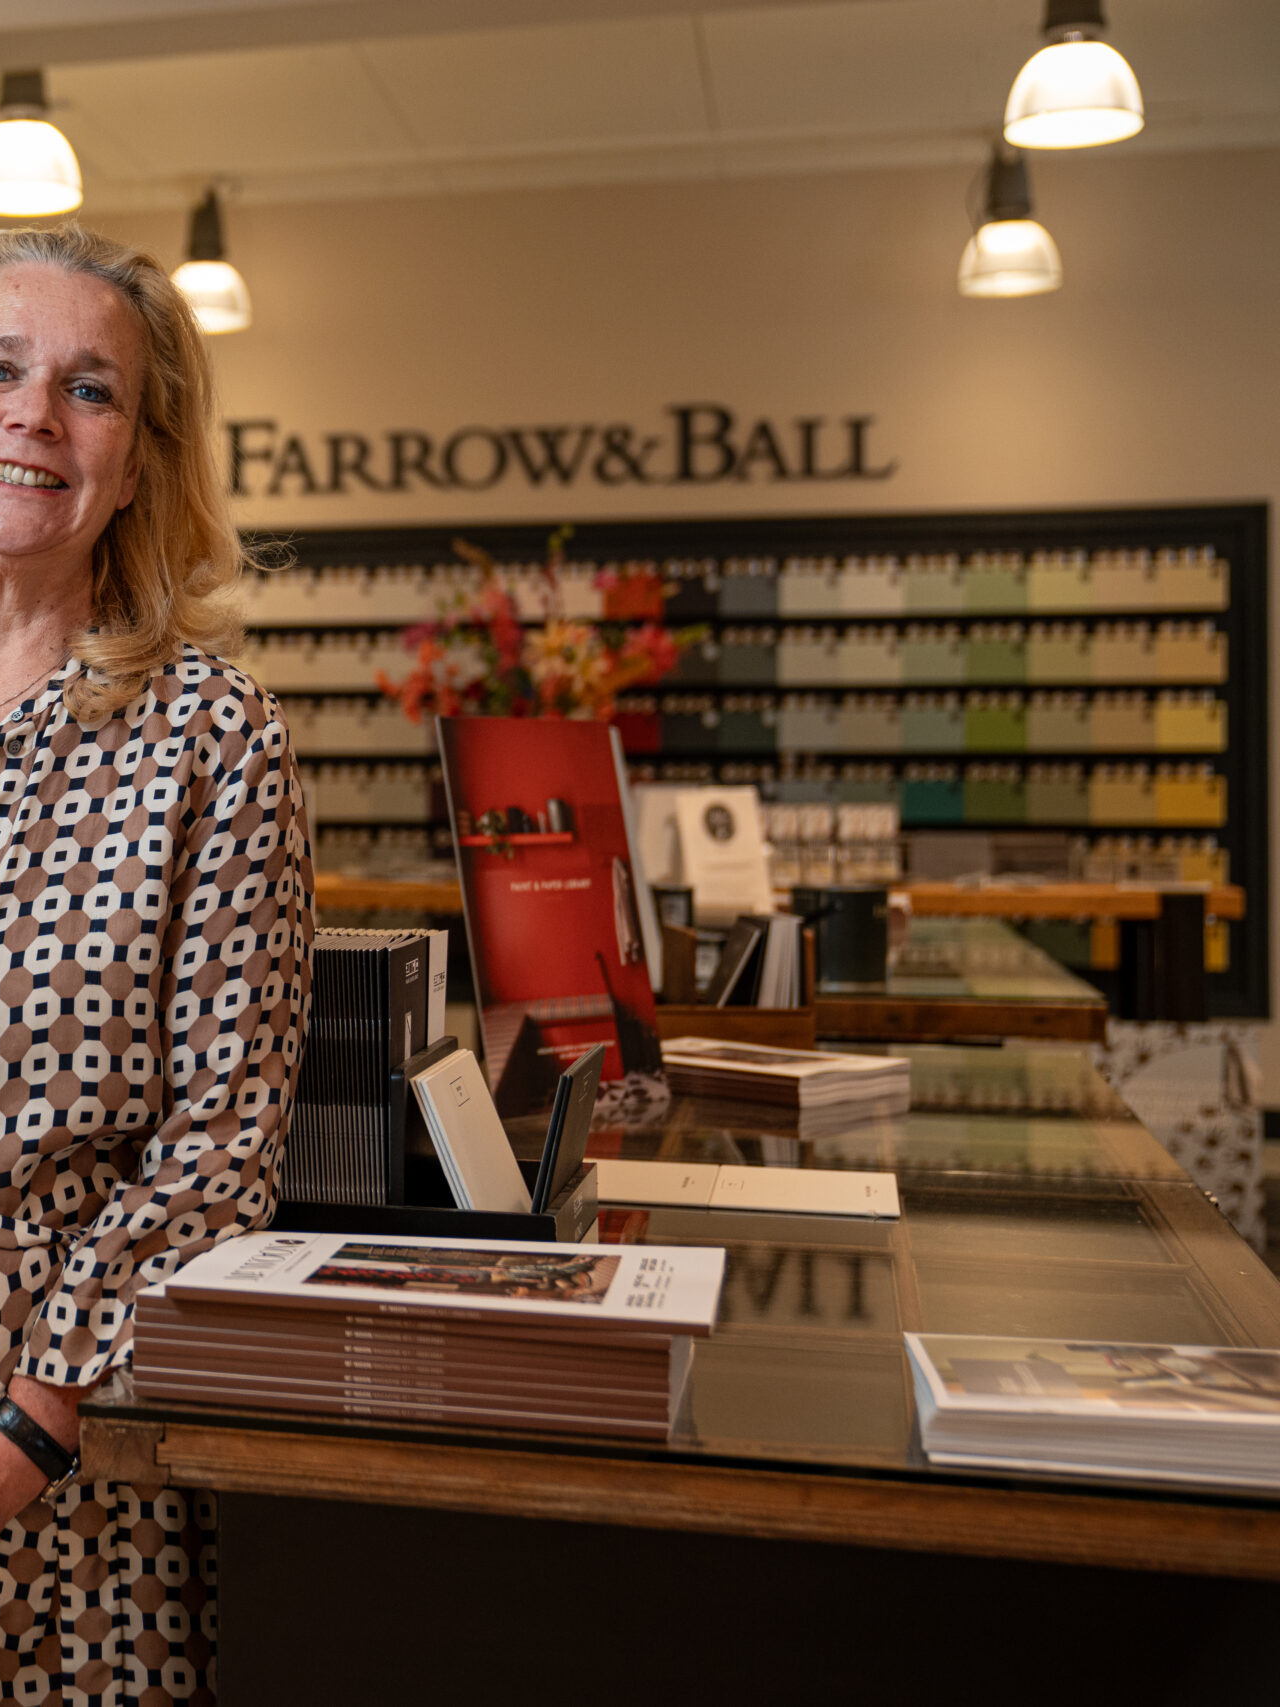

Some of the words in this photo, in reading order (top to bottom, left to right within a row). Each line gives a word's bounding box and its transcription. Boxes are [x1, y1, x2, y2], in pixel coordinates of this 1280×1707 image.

[510, 881, 531, 892] PAINT
[541, 880, 562, 890] PAPER
[565, 878, 592, 889] LIBRARY
